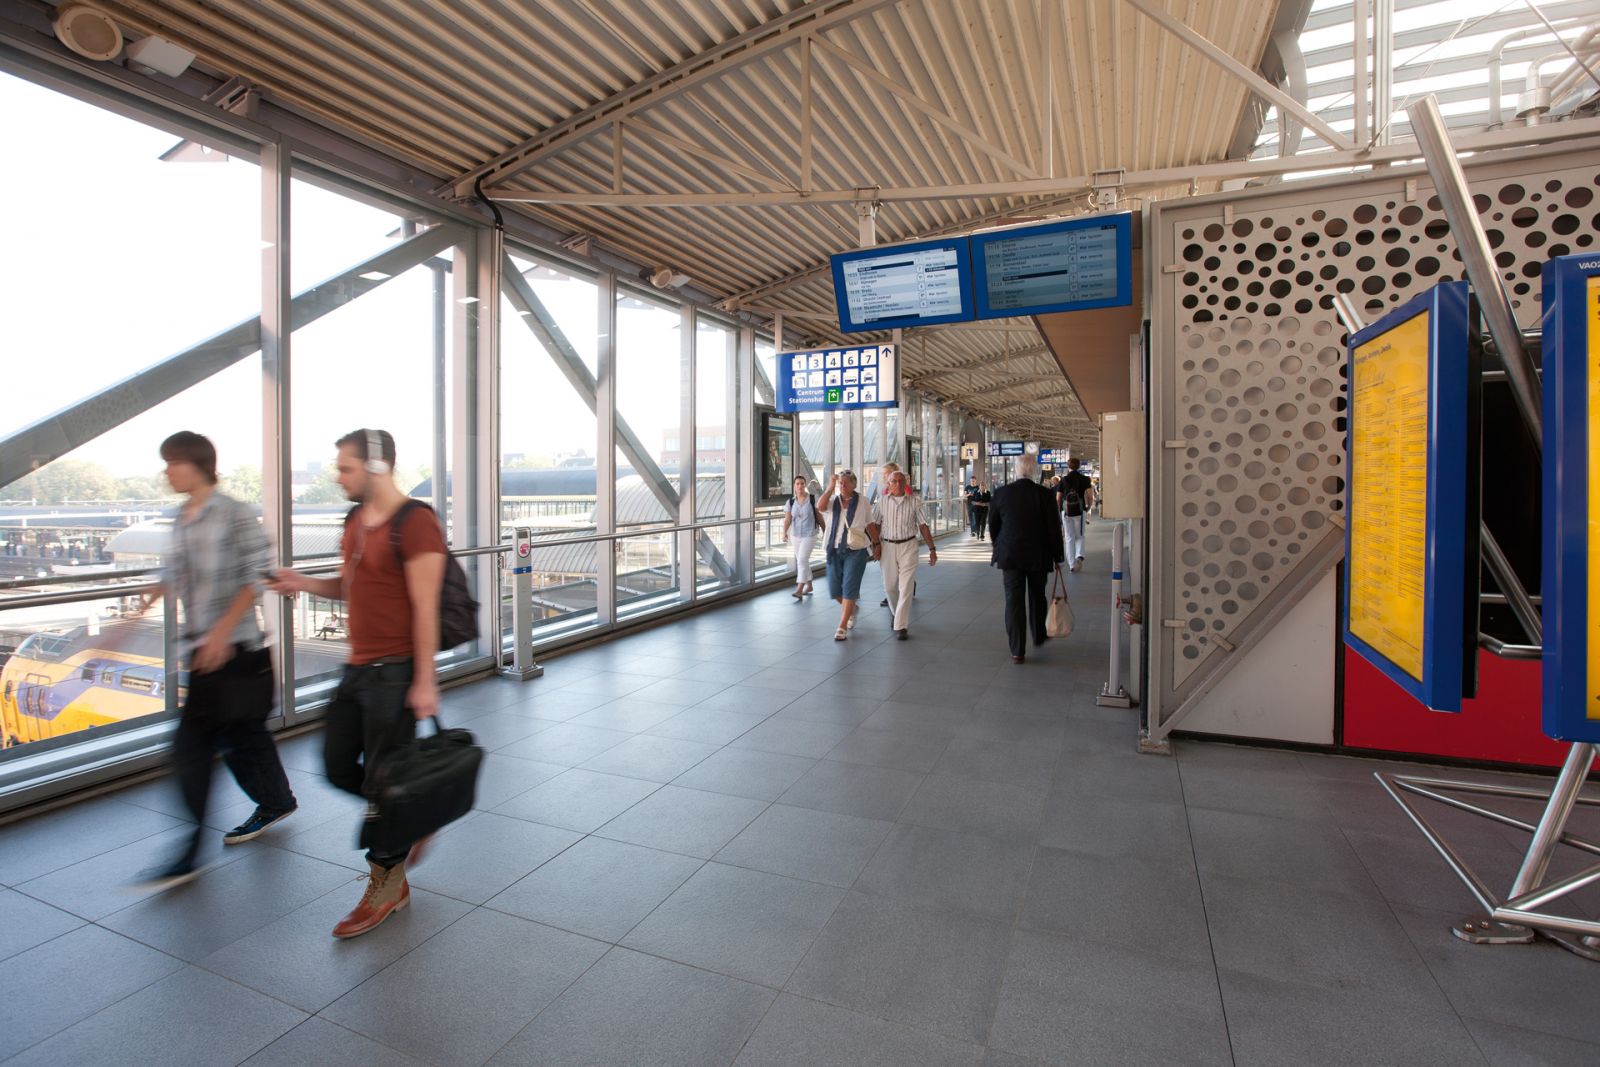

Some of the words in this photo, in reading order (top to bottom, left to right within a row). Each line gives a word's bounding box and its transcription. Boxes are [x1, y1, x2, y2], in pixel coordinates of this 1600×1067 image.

[797, 360, 802, 369] 1
[813, 359, 819, 368] 3
[830, 357, 836, 367] 4
[847, 356, 854, 365] 6
[865, 355, 872, 364] 7
[788, 396, 824, 404] Stationshal
[847, 391, 854, 401] P
[151, 681, 159, 696] 2
